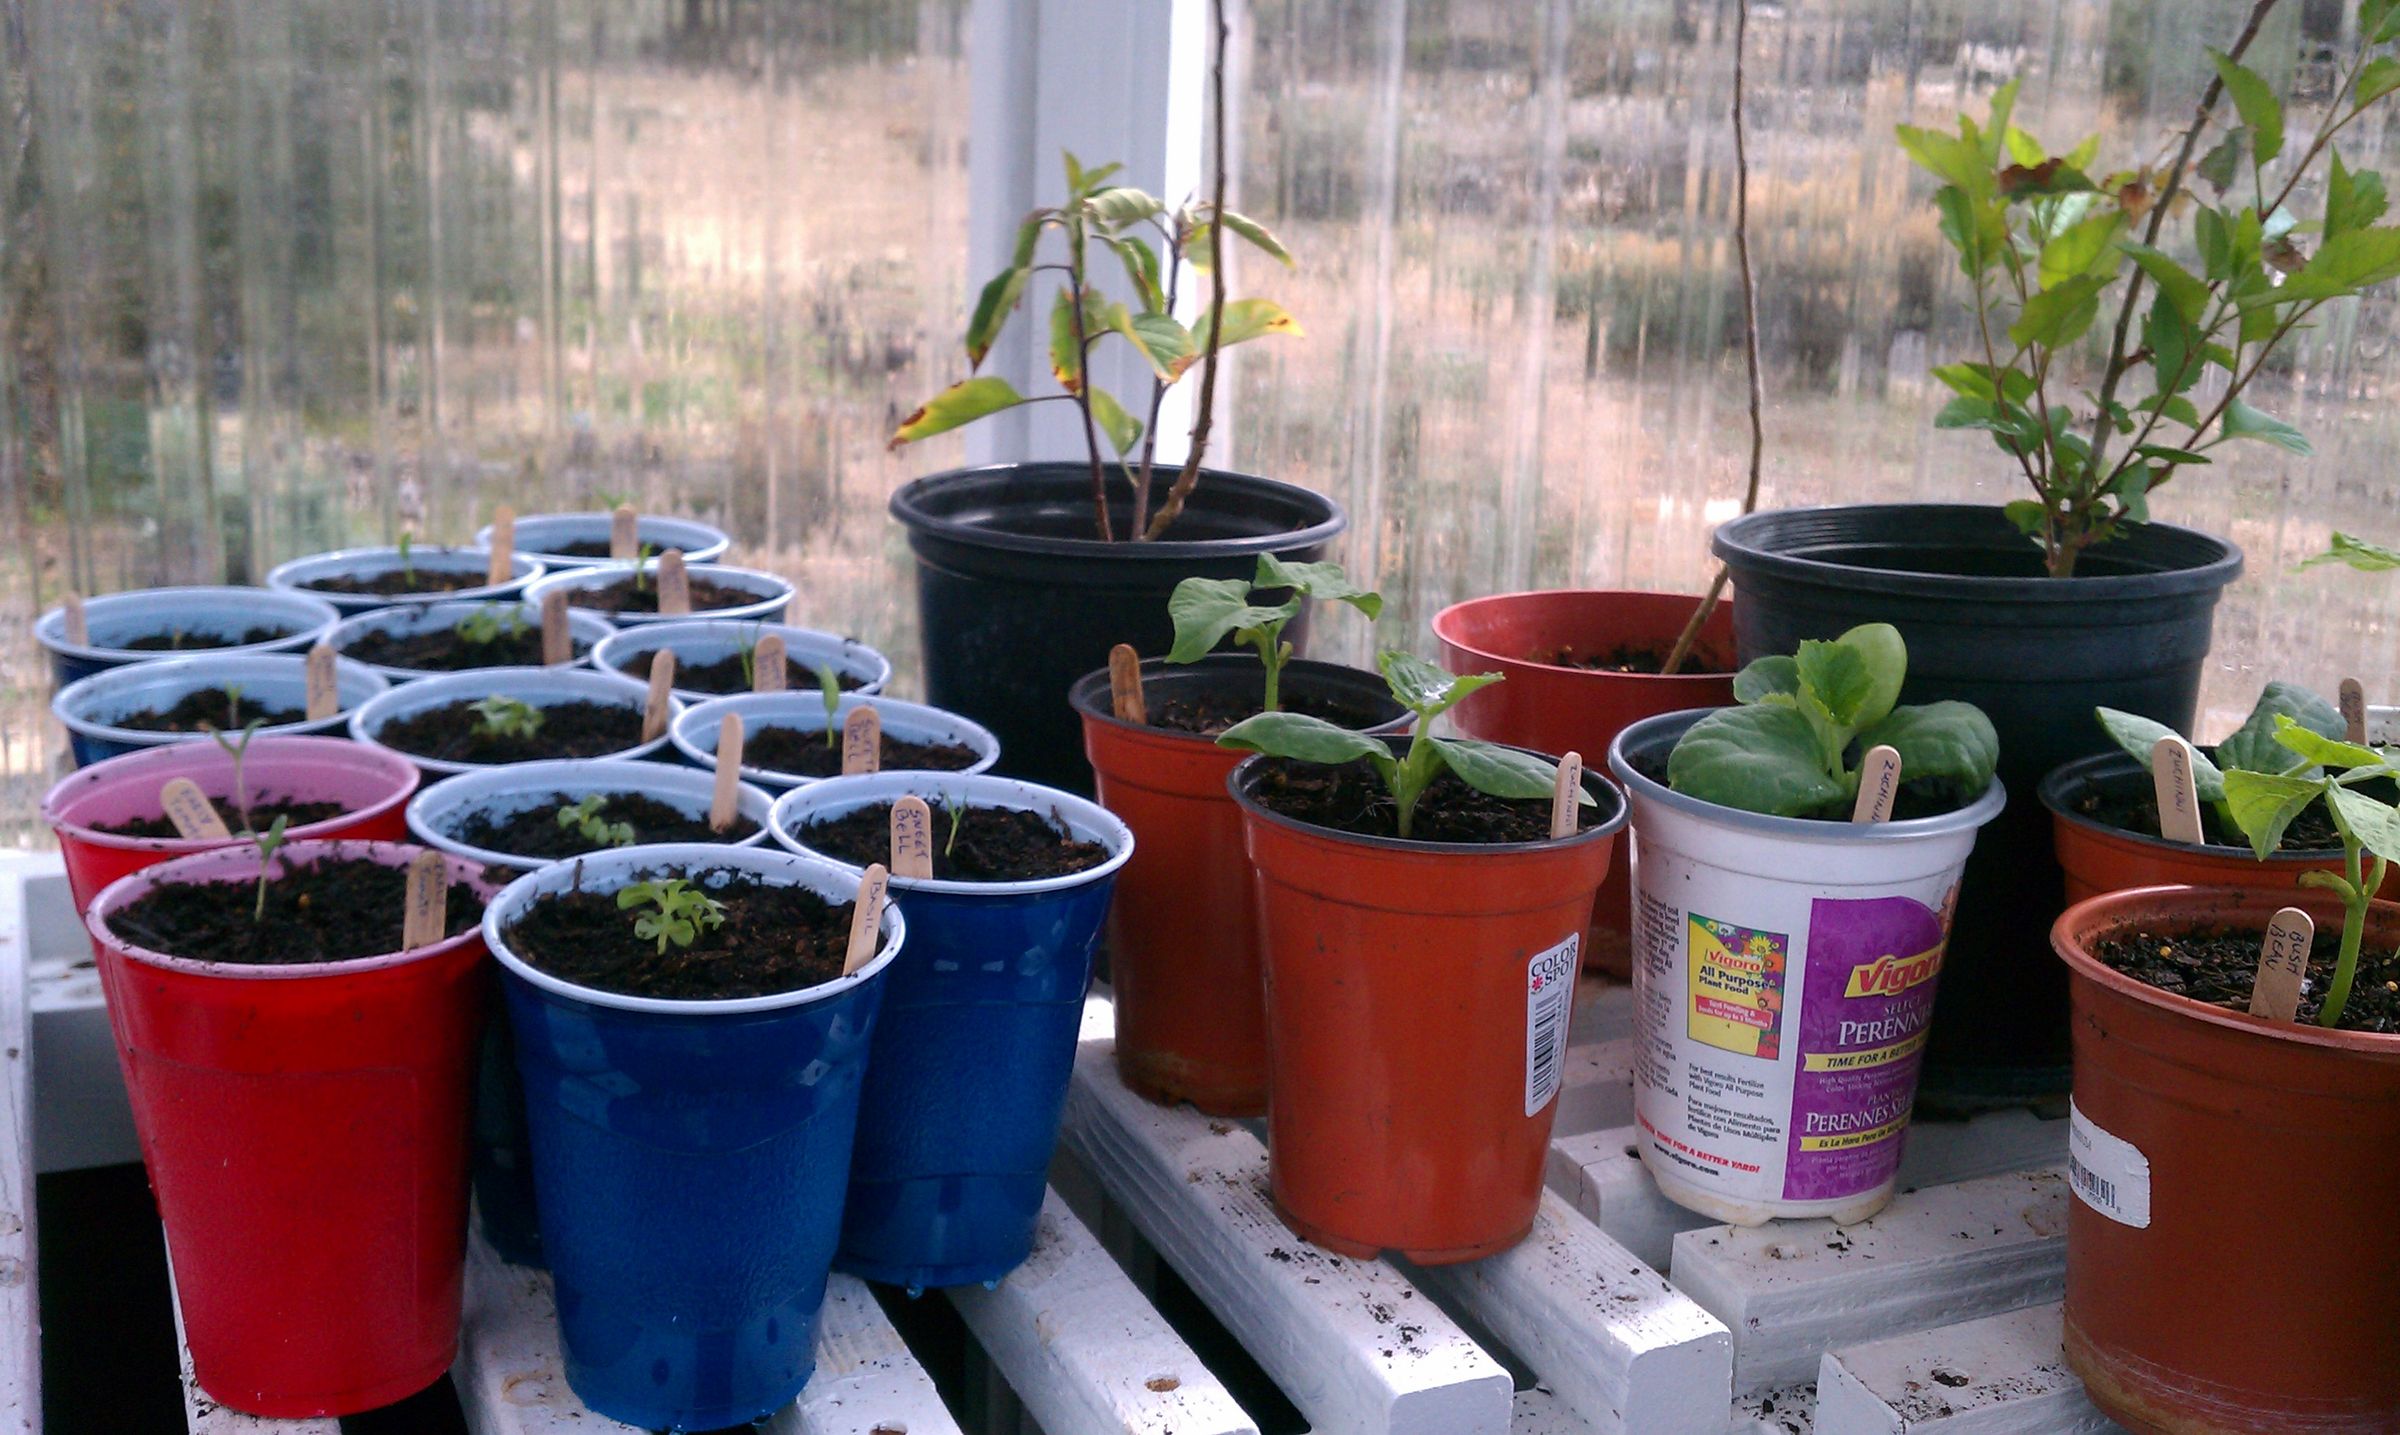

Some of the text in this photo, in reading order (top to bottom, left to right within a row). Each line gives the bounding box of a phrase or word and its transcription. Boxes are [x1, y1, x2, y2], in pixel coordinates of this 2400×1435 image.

[864, 881, 883, 936] BASIL
[2264, 923, 2286, 971] BEAN
[2288, 930, 2305, 977] BUSH
[1531, 941, 1577, 978] COLOR
[1544, 955, 1576, 987] SPOT
[1709, 950, 1761, 972] Vigoro
[1699, 975, 1749, 996] Plant Food
[1700, 965, 1769, 990] All Purpose
[1723, 1011, 1732, 1020] up
[1826, 1056, 1856, 1069] TIME
[1857, 1052, 1880, 1066] FOR
[1880, 1050, 1888, 1061] A
[1688, 1062, 1765, 1089] For best results Fertilize
[1689, 1072, 1764, 1099] with Vigoro All Purpose
[1688, 1080, 1722, 1098] Plant Food
[1687, 1094, 1703, 1108] Para
[1704, 1101, 1732, 1117] mejores
[1687, 1113, 1712, 1128] Plantas
[1712, 1122, 1722, 1131] de
[1723, 1125, 1741, 1136] Usos
[1687, 1122, 1697, 1132] de
[1713, 1114, 1727, 1124] con
[1727, 1117, 1762, 1132] Alimento
[1762, 1126, 1781, 1135] para
[1805, 1104, 1888, 1133] PERENNES
[1818, 1139, 1829, 1149] Es
[1829, 1137, 1840, 1148] La
[1841, 1136, 1861, 1146] Hora
[1672, 1139, 1689, 1153] FOR
[1688, 1146, 1696, 1157] A
[1696, 1150, 1729, 1167] BETTER
[1731, 1159, 1761, 1174] YARD!
